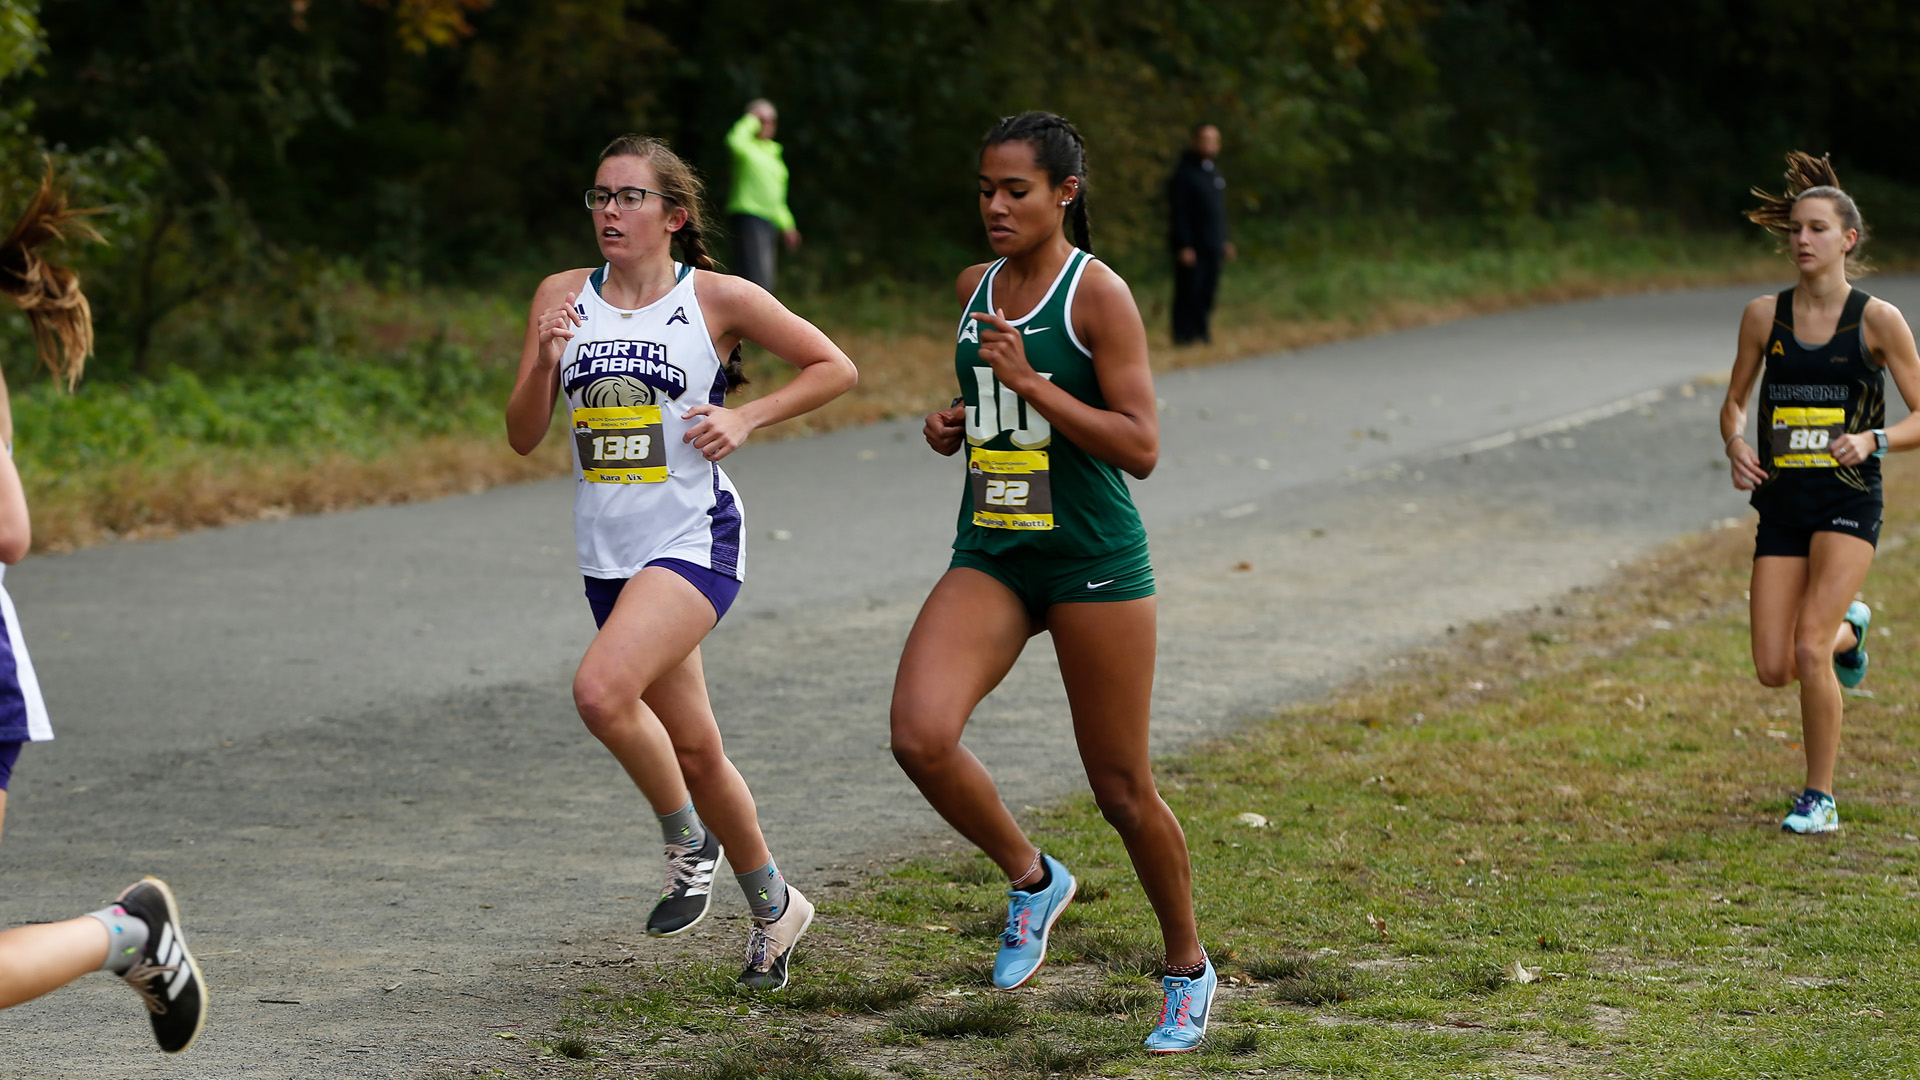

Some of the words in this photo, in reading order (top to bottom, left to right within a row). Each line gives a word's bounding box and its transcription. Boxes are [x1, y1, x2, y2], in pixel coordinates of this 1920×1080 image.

[578, 341, 666, 362] NORTH
[564, 358, 686, 388] ALABAMA
[1768, 384, 1849, 401] LIPSCOMB
[964, 366, 1053, 450] JU
[592, 434, 651, 461] 138
[1789, 429, 1830, 450] 80
[600, 474, 621, 482] Kara
[985, 479, 1031, 507] 22
[1012, 520, 1046, 528] Palotti
